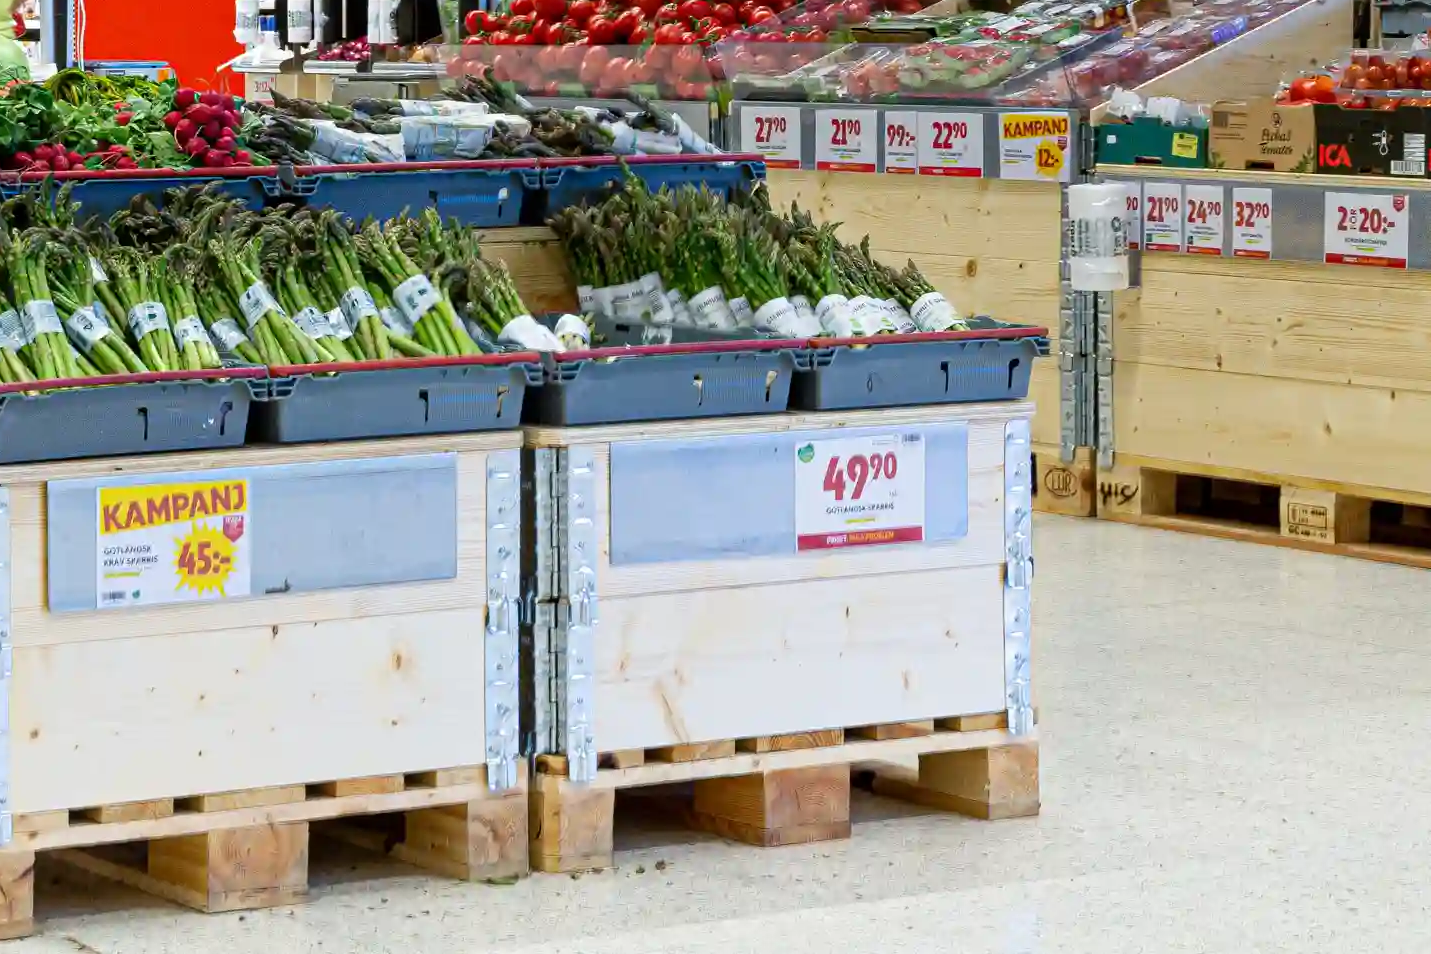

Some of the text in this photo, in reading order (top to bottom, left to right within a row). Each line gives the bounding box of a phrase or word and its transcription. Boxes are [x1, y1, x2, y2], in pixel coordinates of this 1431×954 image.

[1003, 117, 1068, 139] KAMPANJ
[1319, 144, 1353, 168] ICA
[1359, 207, 1396, 234] 20:-
[103, 483, 245, 532] KAMPANJ
[178, 540, 231, 576] 45:-
